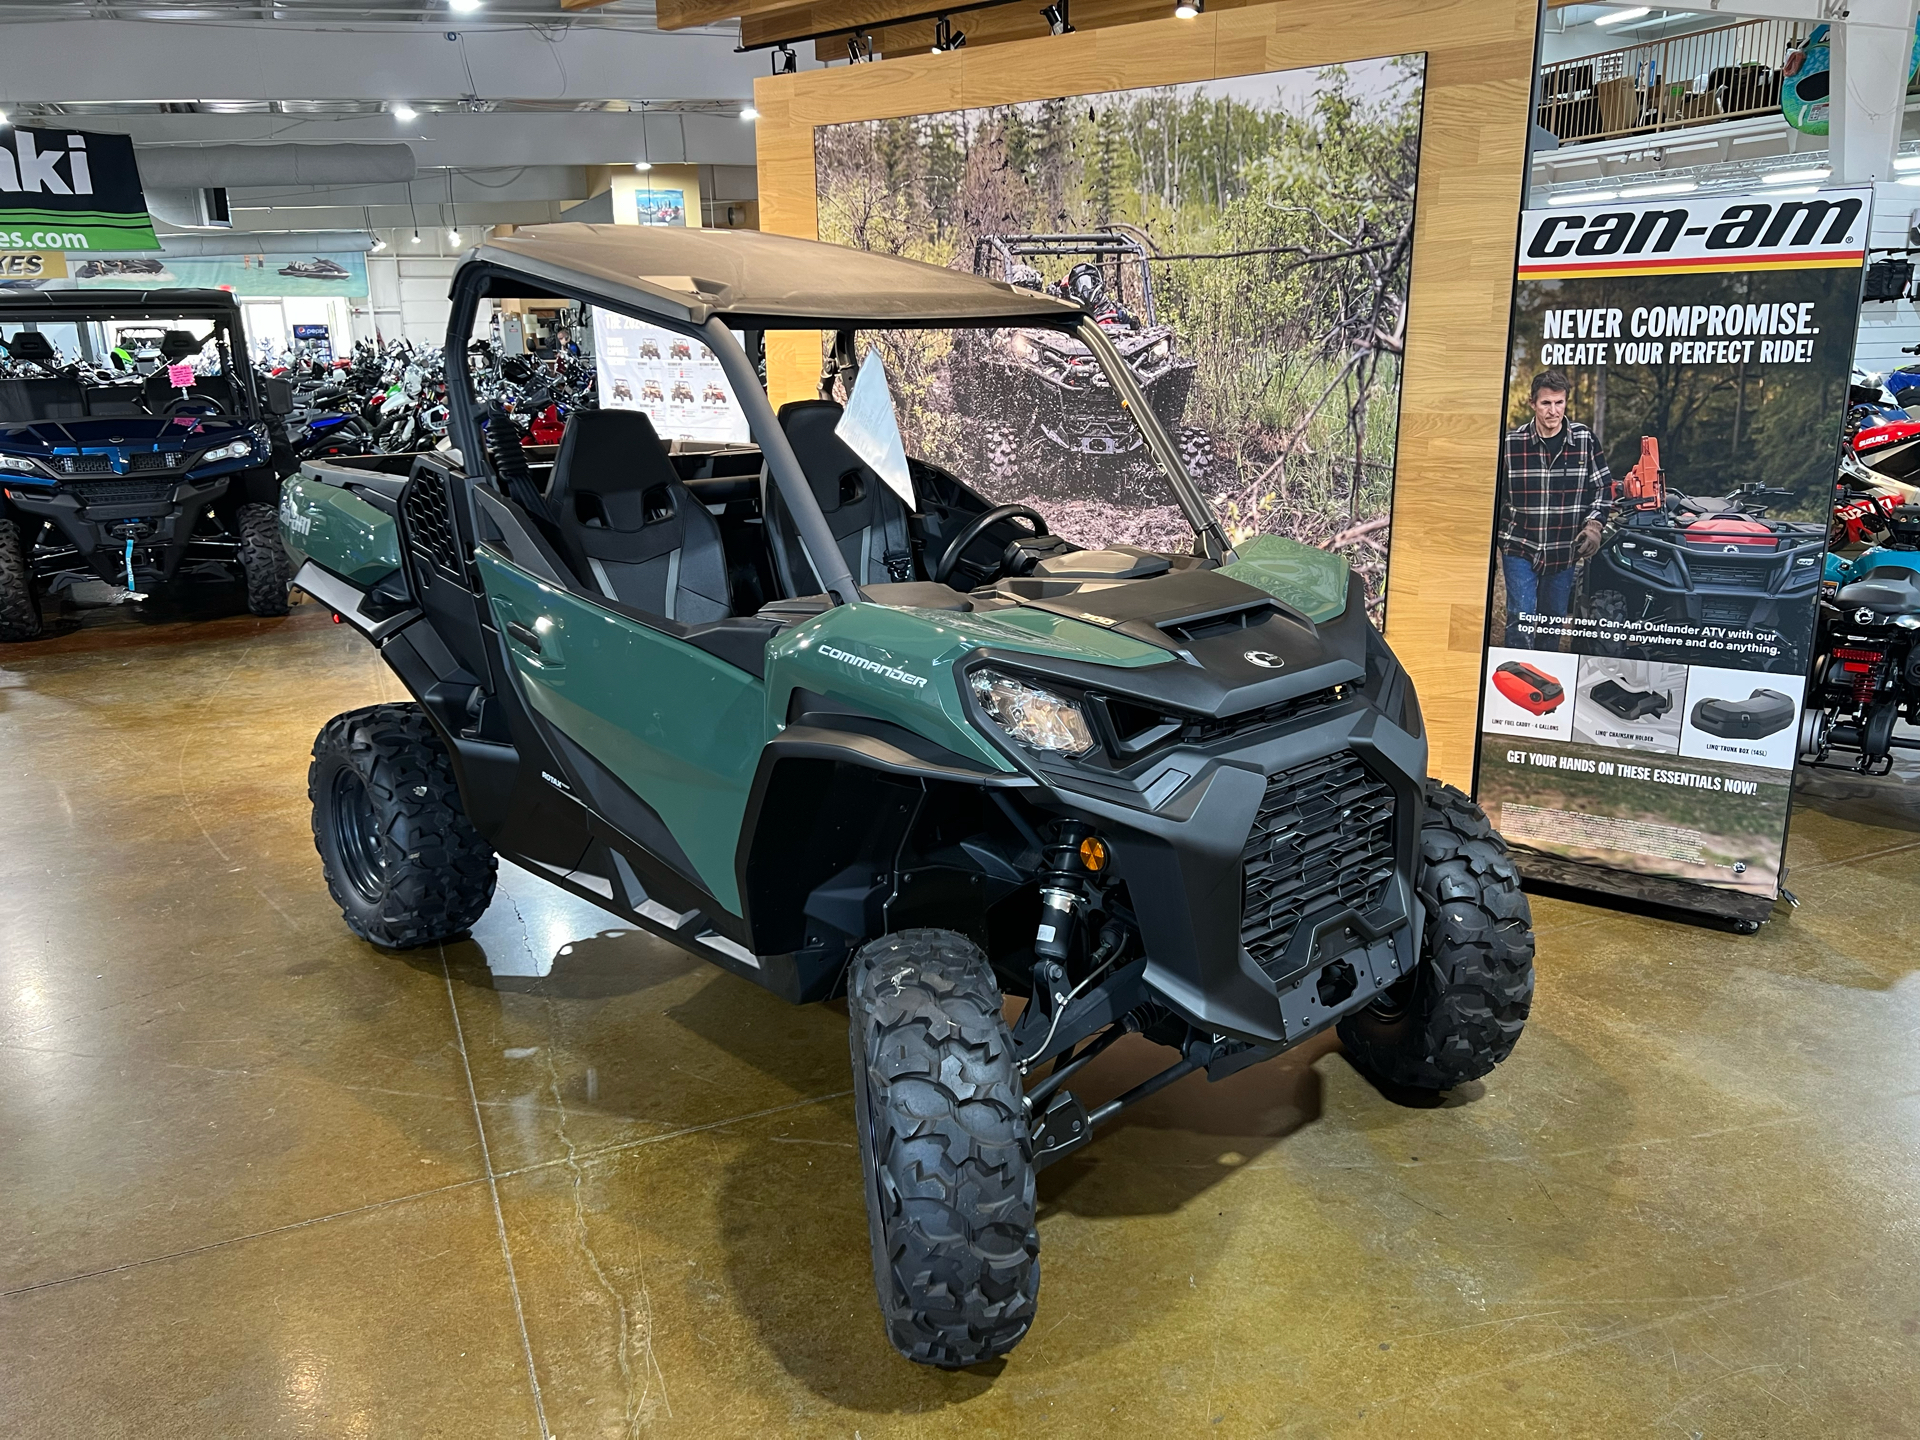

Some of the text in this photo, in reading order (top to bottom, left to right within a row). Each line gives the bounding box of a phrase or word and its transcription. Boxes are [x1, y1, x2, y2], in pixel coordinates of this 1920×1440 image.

[1527, 198, 1862, 258] can-am
[1543, 303, 1820, 339] NEVER COMPROMISE.
[1541, 339, 1814, 366] CREATE YOUR PERFECT RIDE!
[1858, 434, 1889, 448] SUZUKI
[1518, 611, 1777, 642] Equip your new Can-Am Outlander ATV with our
[1518, 624, 1781, 656] top accessories to go anywhere and do anything.
[818, 644, 928, 688] COMMANDER
[1609, 731, 1634, 740] CHAINSAW
[1720, 745, 1738, 753] TRUNK
[1506, 750, 1757, 796] GET YOUR HANDS ON THESE ESSENTIALS NOW!
